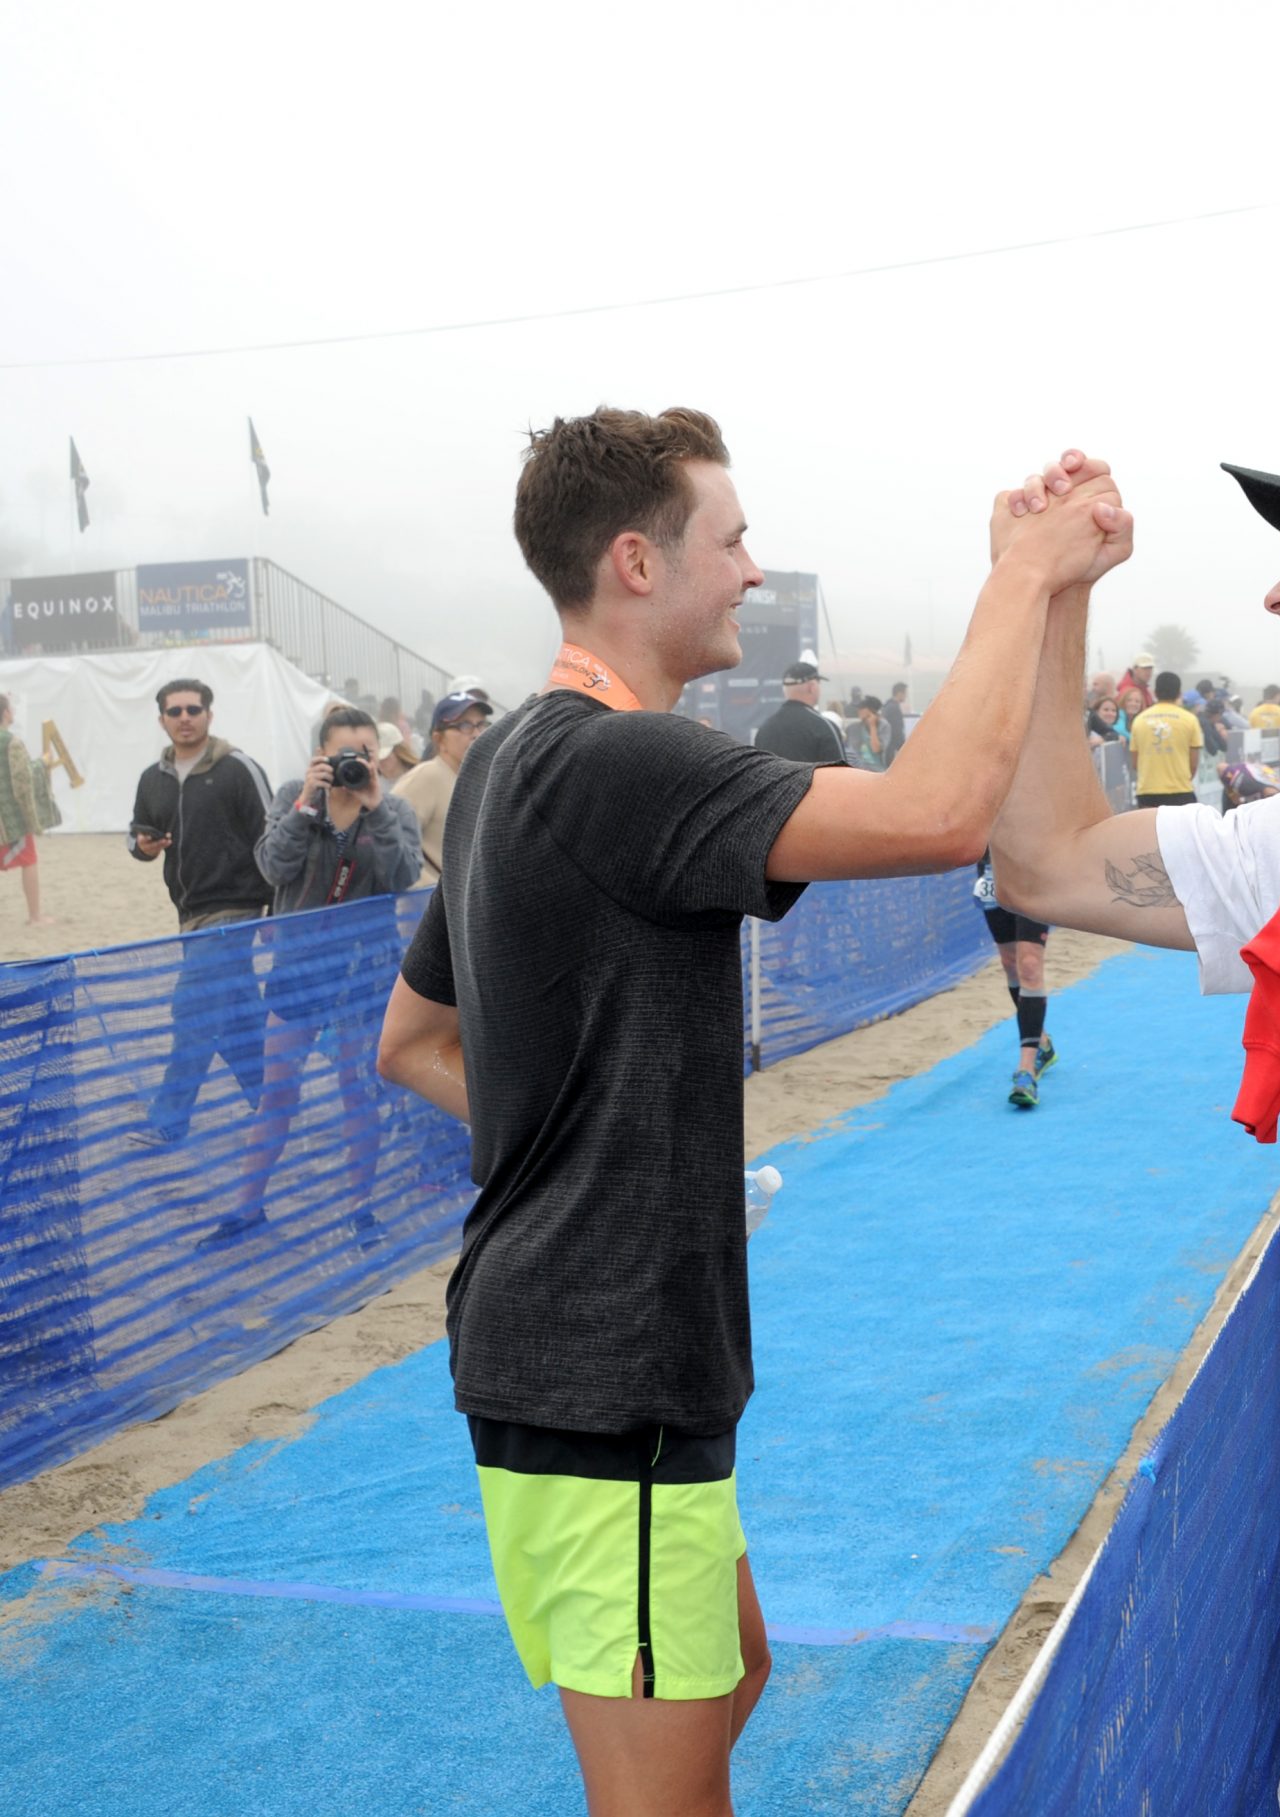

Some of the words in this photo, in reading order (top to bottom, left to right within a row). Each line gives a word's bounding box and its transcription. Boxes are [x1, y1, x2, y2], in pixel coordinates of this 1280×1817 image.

[139, 584, 230, 606] NAUTICA
[14, 596, 114, 620] EQUINOX
[139, 604, 181, 616] MALIBU
[185, 600, 246, 614] TRIATHLON
